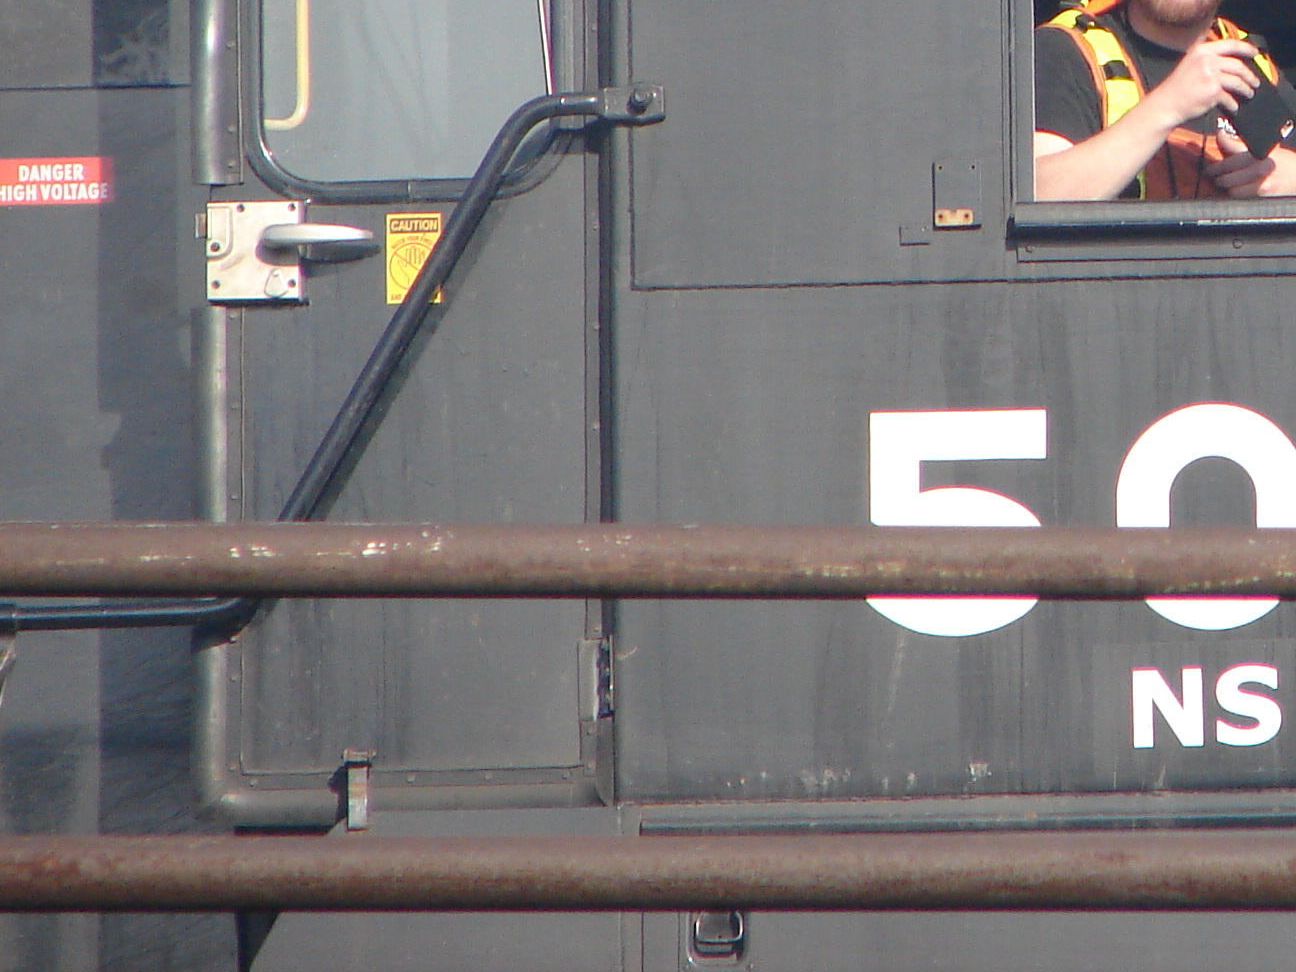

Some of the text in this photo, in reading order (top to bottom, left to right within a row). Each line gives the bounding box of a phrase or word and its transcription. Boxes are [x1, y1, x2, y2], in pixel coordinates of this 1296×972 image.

[18, 163, 84, 182] DANGER
[0, 182, 108, 202] HIGH VOLTAGE
[390, 218, 438, 232] CAUTION
[1131, 663, 1283, 748] NS
